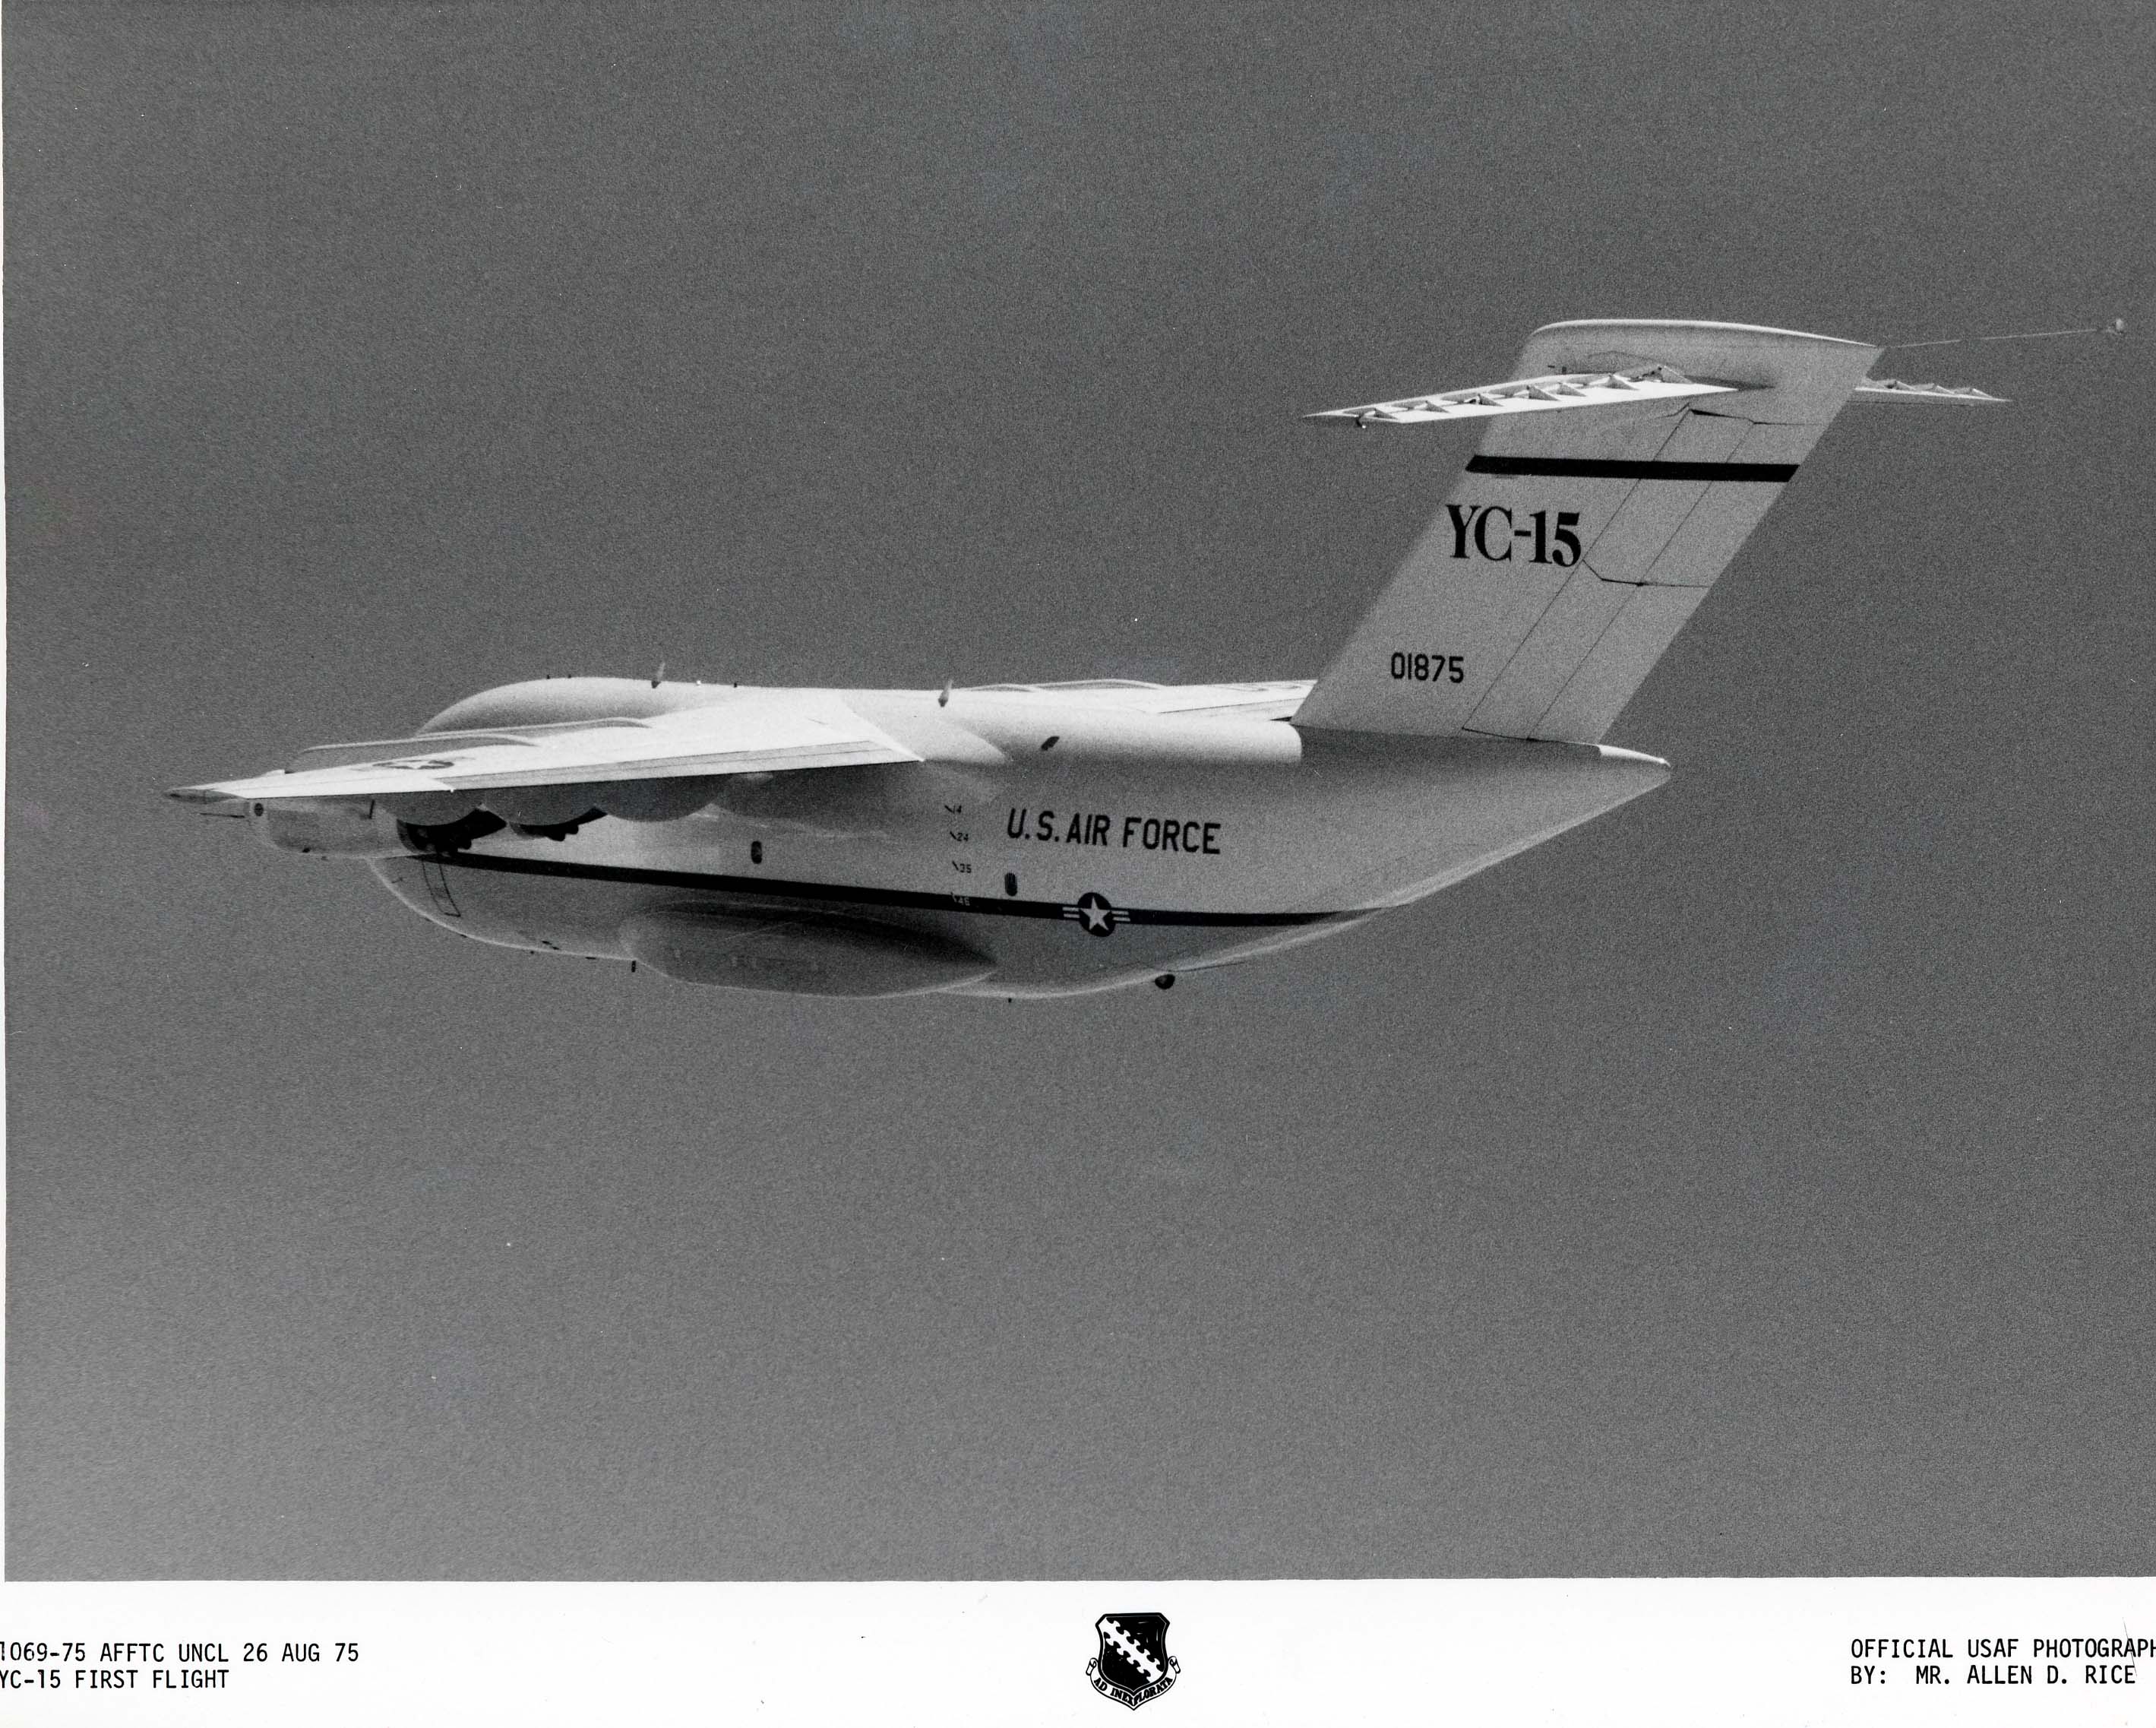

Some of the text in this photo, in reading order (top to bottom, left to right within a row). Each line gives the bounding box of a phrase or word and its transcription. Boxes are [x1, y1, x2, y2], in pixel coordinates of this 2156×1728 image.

[1445, 504, 1582, 568] YC-15
[1390, 652, 1464, 683] 01875
[956, 832, 969, 842] 24
[1007, 808, 1222, 855] U.S. AIR FORCE
[959, 863, 972, 873] 35
